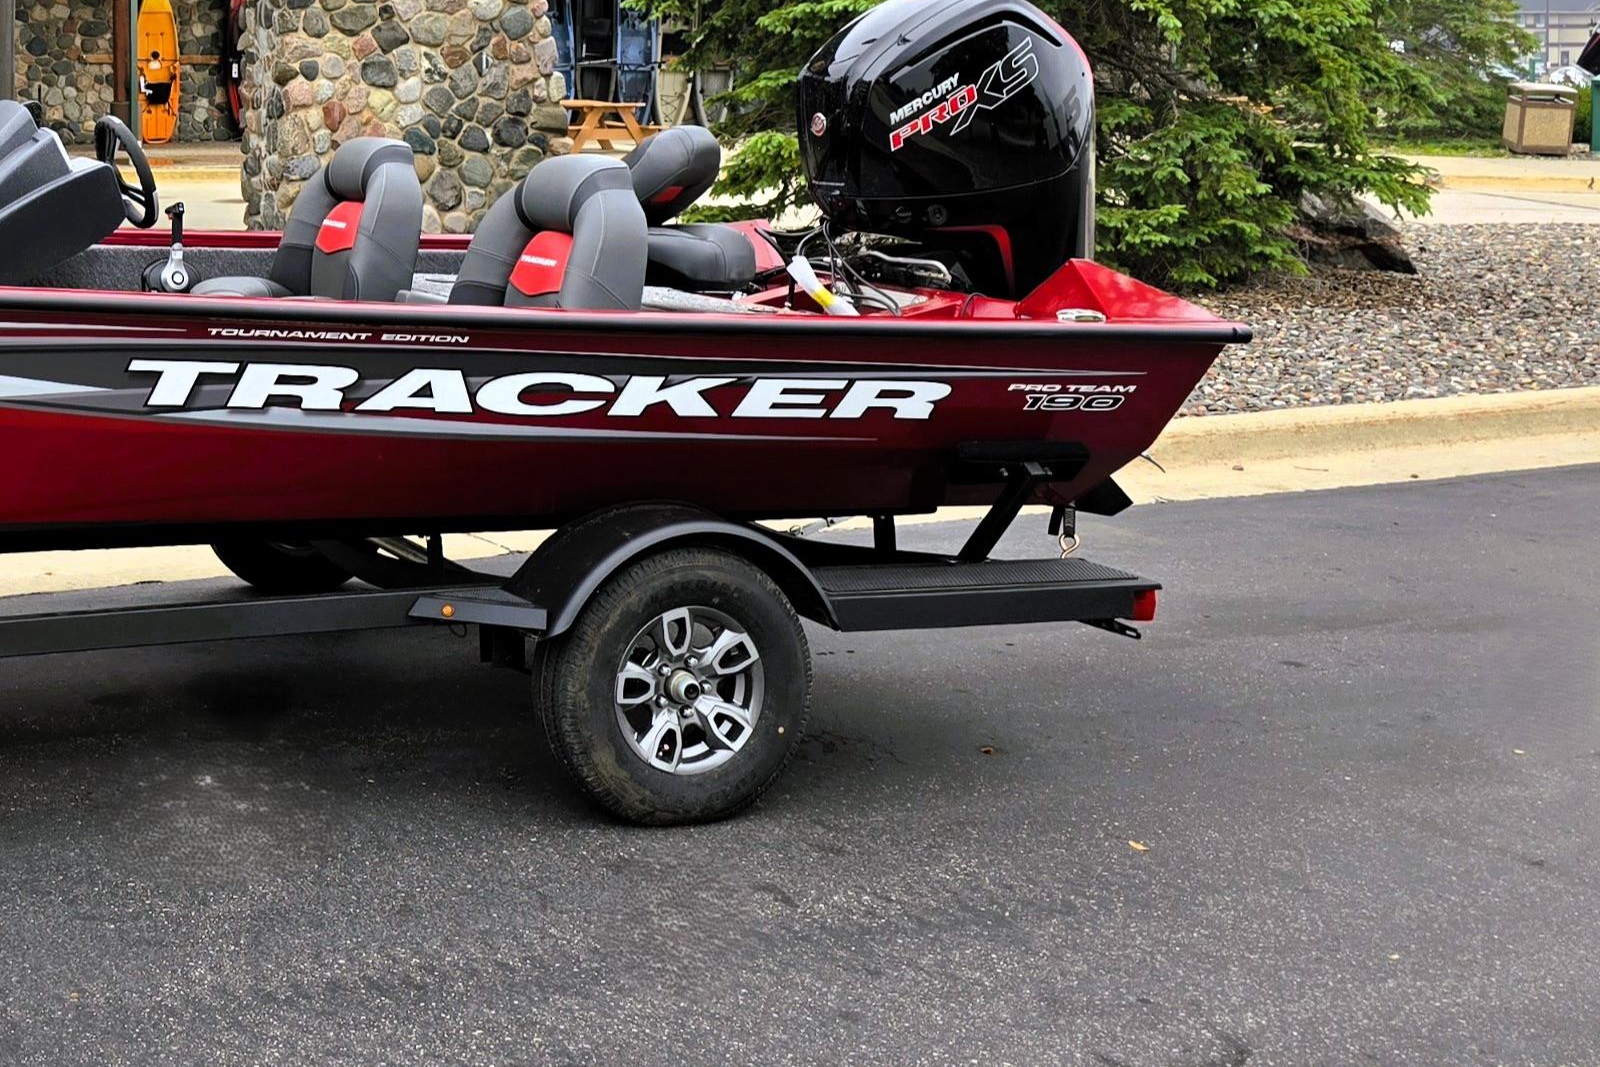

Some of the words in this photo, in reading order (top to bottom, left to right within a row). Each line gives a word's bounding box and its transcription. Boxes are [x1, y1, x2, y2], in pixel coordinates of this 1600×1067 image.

[889, 72, 960, 126] MERCURY
[889, 83, 978, 151] PRO
[207, 328, 372, 341] TOURNAMENT
[380, 334, 470, 343] EDITION
[126, 358, 952, 420] TRACKER
[1008, 384, 1062, 392] PRO
[1066, 384, 1137, 393] TEAM
[1023, 394, 1125, 411] 190
